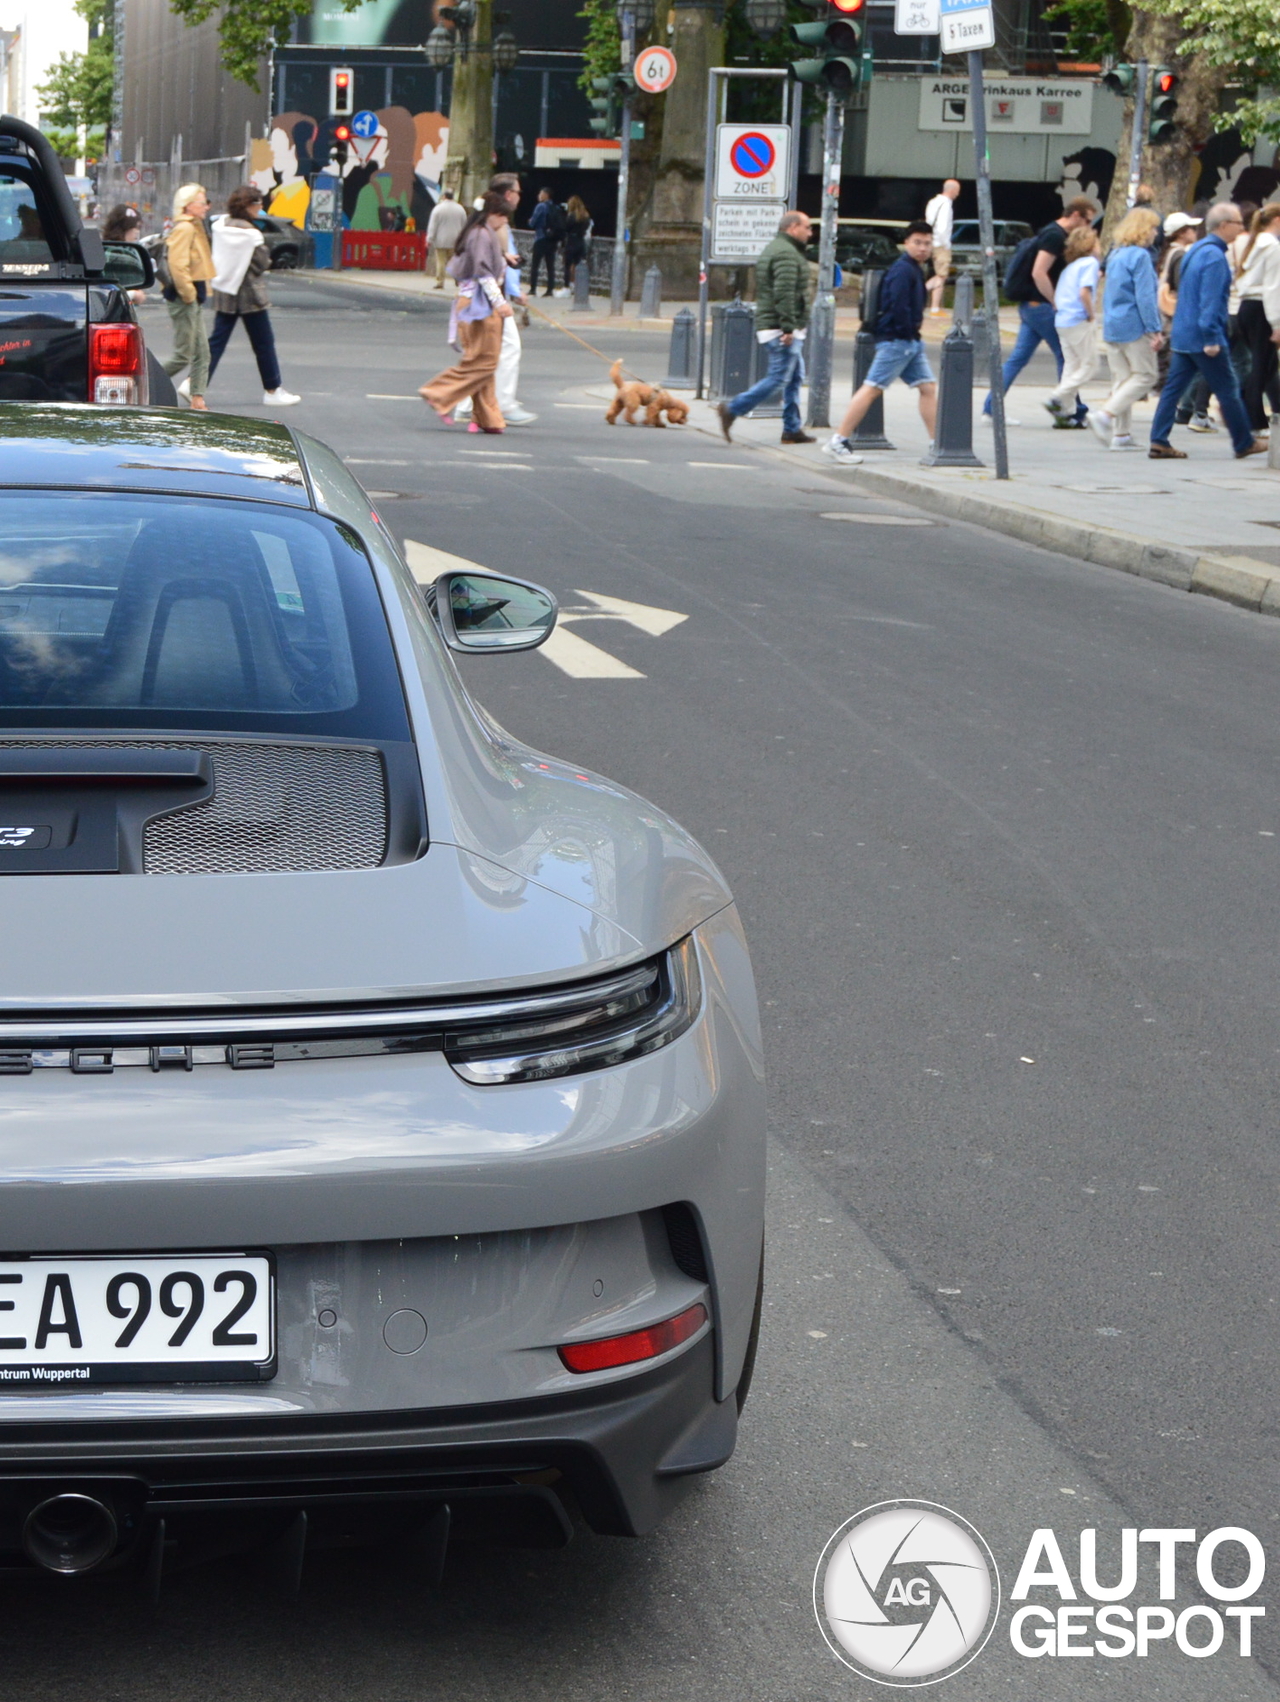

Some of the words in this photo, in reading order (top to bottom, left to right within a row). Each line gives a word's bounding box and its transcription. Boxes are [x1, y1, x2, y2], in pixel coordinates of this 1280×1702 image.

[957, 22, 984, 38] Taxen
[932, 83, 969, 95] ARGE
[983, 84, 1032, 96] rinkaus
[1036, 87, 1082, 98] Karree
[734, 182, 768, 194] ZONE
[720, 208, 743, 216] Parken
[106, 1270, 257, 1348] 992
[32, 1367, 90, 1381] Wuppertal
